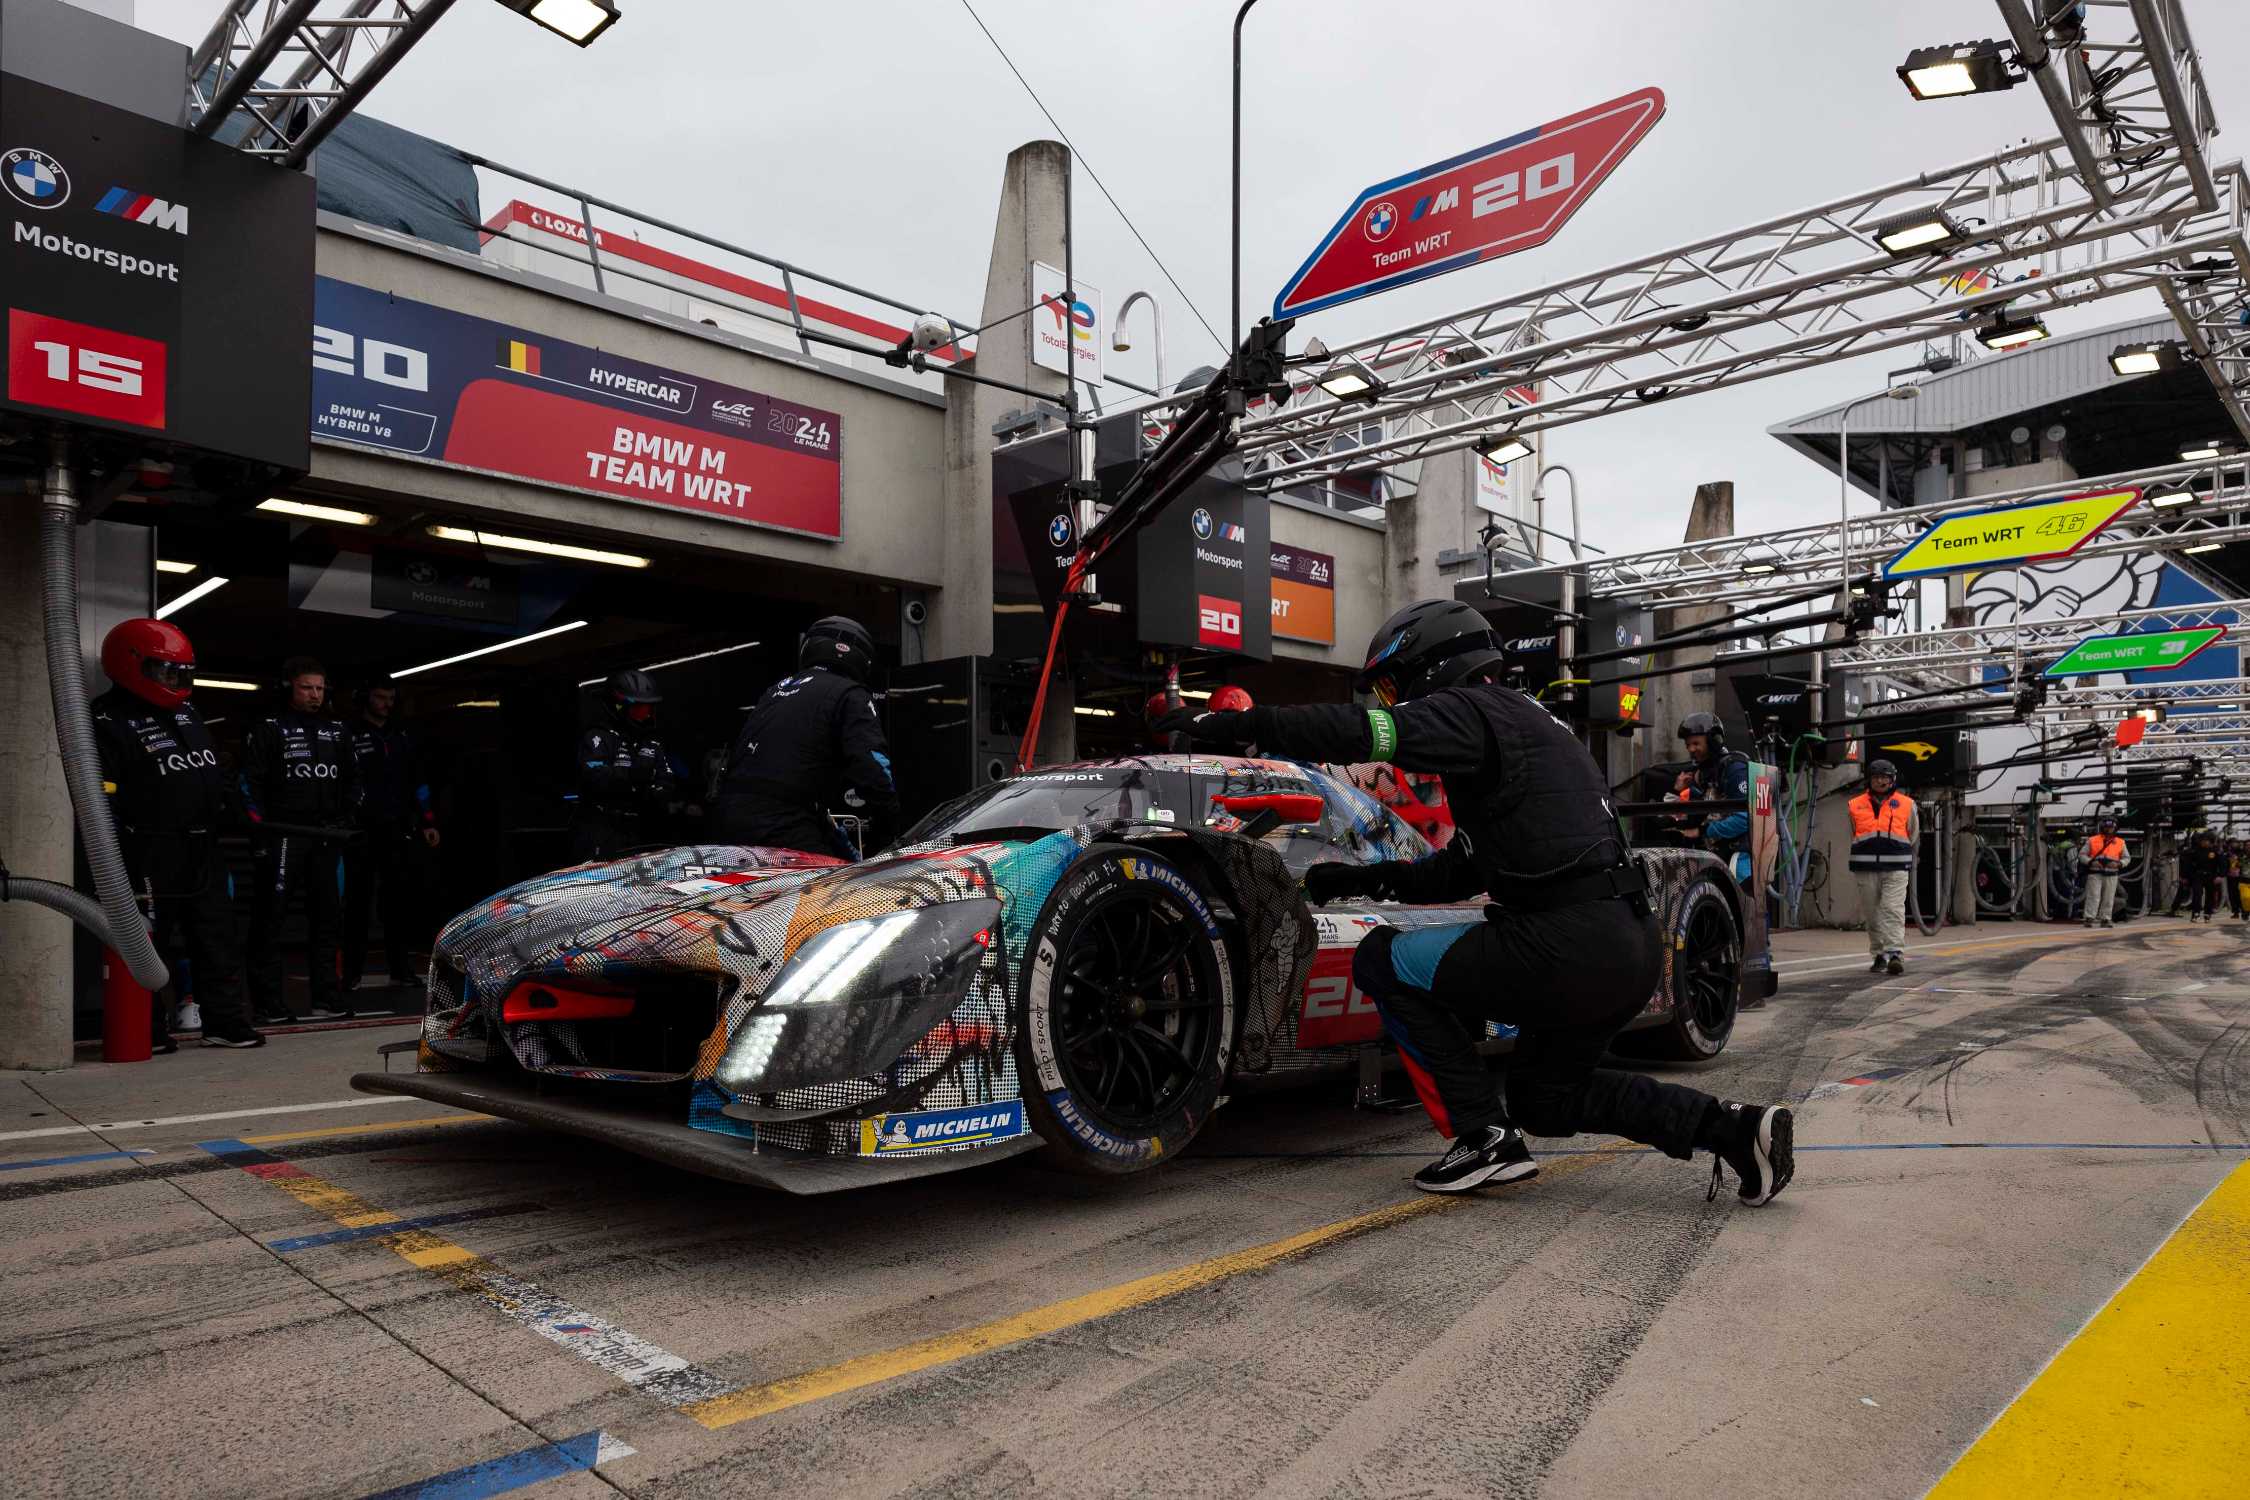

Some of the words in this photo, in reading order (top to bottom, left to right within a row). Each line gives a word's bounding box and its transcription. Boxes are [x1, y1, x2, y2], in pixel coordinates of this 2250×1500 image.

[9, 151, 62, 176] BMW
[1472, 152, 1575, 219] 20
[14, 221, 180, 283] Motorsport
[1372, 247, 1412, 269] Team
[1414, 230, 1452, 256] WRT
[313, 323, 429, 393] 20
[1041, 331, 1097, 361] TotalEergies
[34, 340, 143, 397] 15
[589, 367, 681, 405] HYPERCAR
[318, 414, 370, 434] HYBRID
[374, 425, 393, 438] V8
[330, 403, 365, 420] BMW
[368, 412, 381, 423] M
[613, 426, 693, 468] BMW
[699, 445, 727, 475] M
[794, 436, 804, 446] LE
[805, 439, 830, 450] MANS
[586, 451, 677, 494] TEAM
[683, 472, 753, 509] WRT
[1932, 535, 1978, 551] Team
[1982, 526, 2025, 544] WRT
[2035, 512, 2088, 537] 46
[1197, 547, 1243, 569] Motorsport
[412, 591, 486, 609] Motorsport
[1200, 608, 1240, 635] 20
[2077, 651, 2112, 661] Team
[2114, 646, 2145, 658] WRT
[2158, 639, 2188, 655] 31
[1371, 713, 1391, 753] PITLANE
[1756, 782, 1770, 810] HY
[1151, 863, 1217, 930] MICHELIN
[1039, 949, 1054, 968] S
[1036, 1003, 1046, 1045] SPORT
[1040, 1049, 1056, 1082] PILOT
[915, 1113, 1012, 1139] MICHELIN
[1055, 1098, 1135, 1157] MICHELIN
